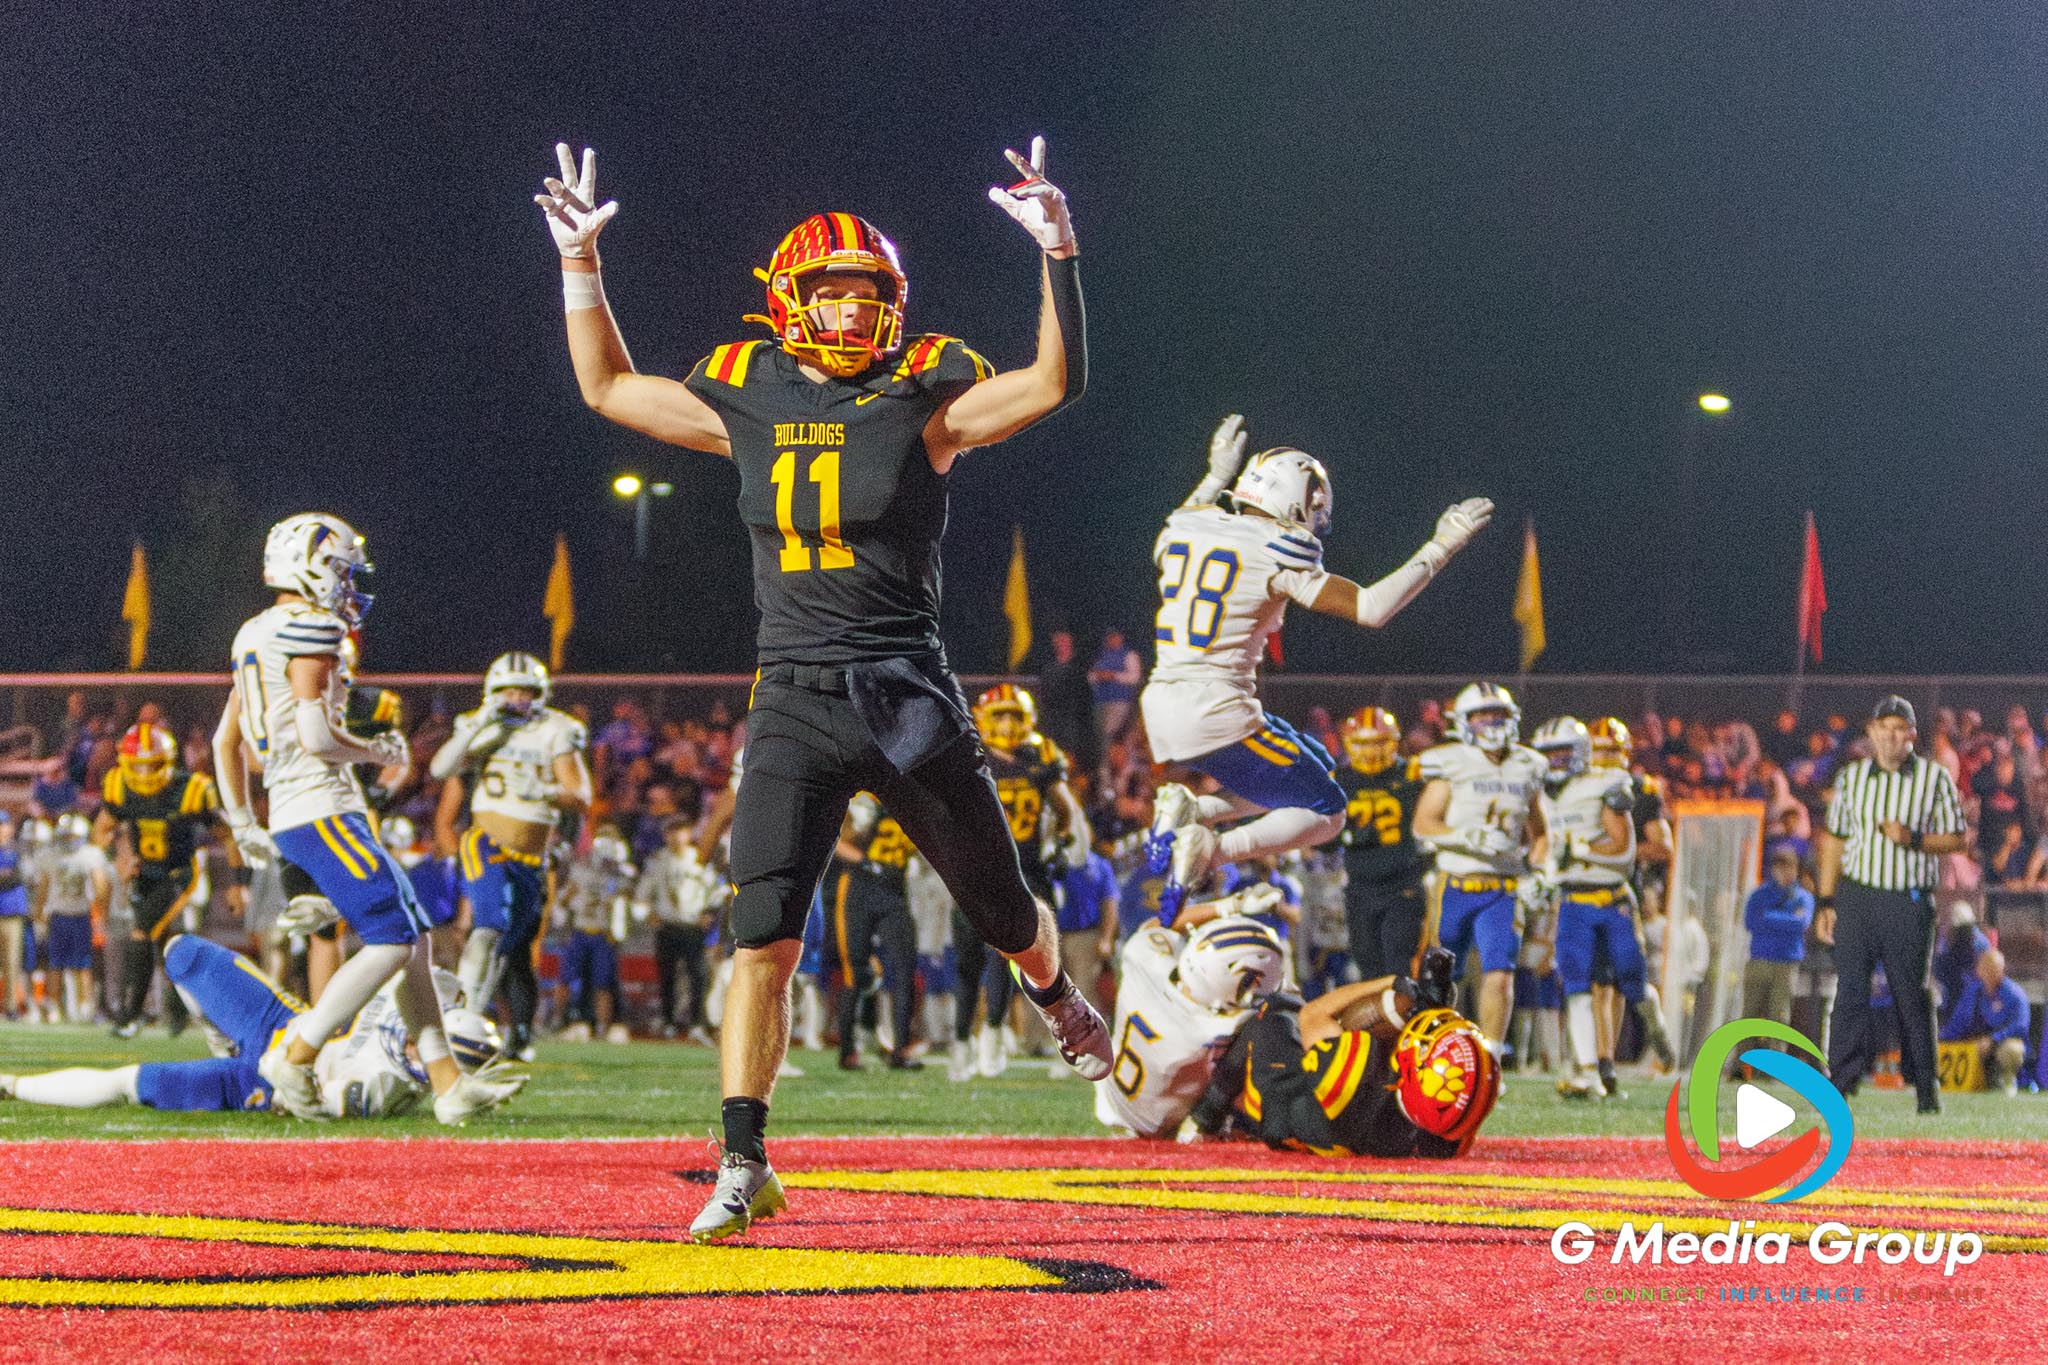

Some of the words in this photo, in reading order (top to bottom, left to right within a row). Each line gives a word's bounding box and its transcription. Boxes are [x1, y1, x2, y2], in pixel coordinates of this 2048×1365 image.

[774, 423, 845, 446] BULLDOGS
[770, 451, 856, 572] 11
[1155, 541, 1243, 654] 28
[231, 648, 270, 755] 0
[1347, 796, 1402, 846] 72
[1112, 1009, 1164, 1101] 6
[1939, 1052, 1969, 1087] 20
